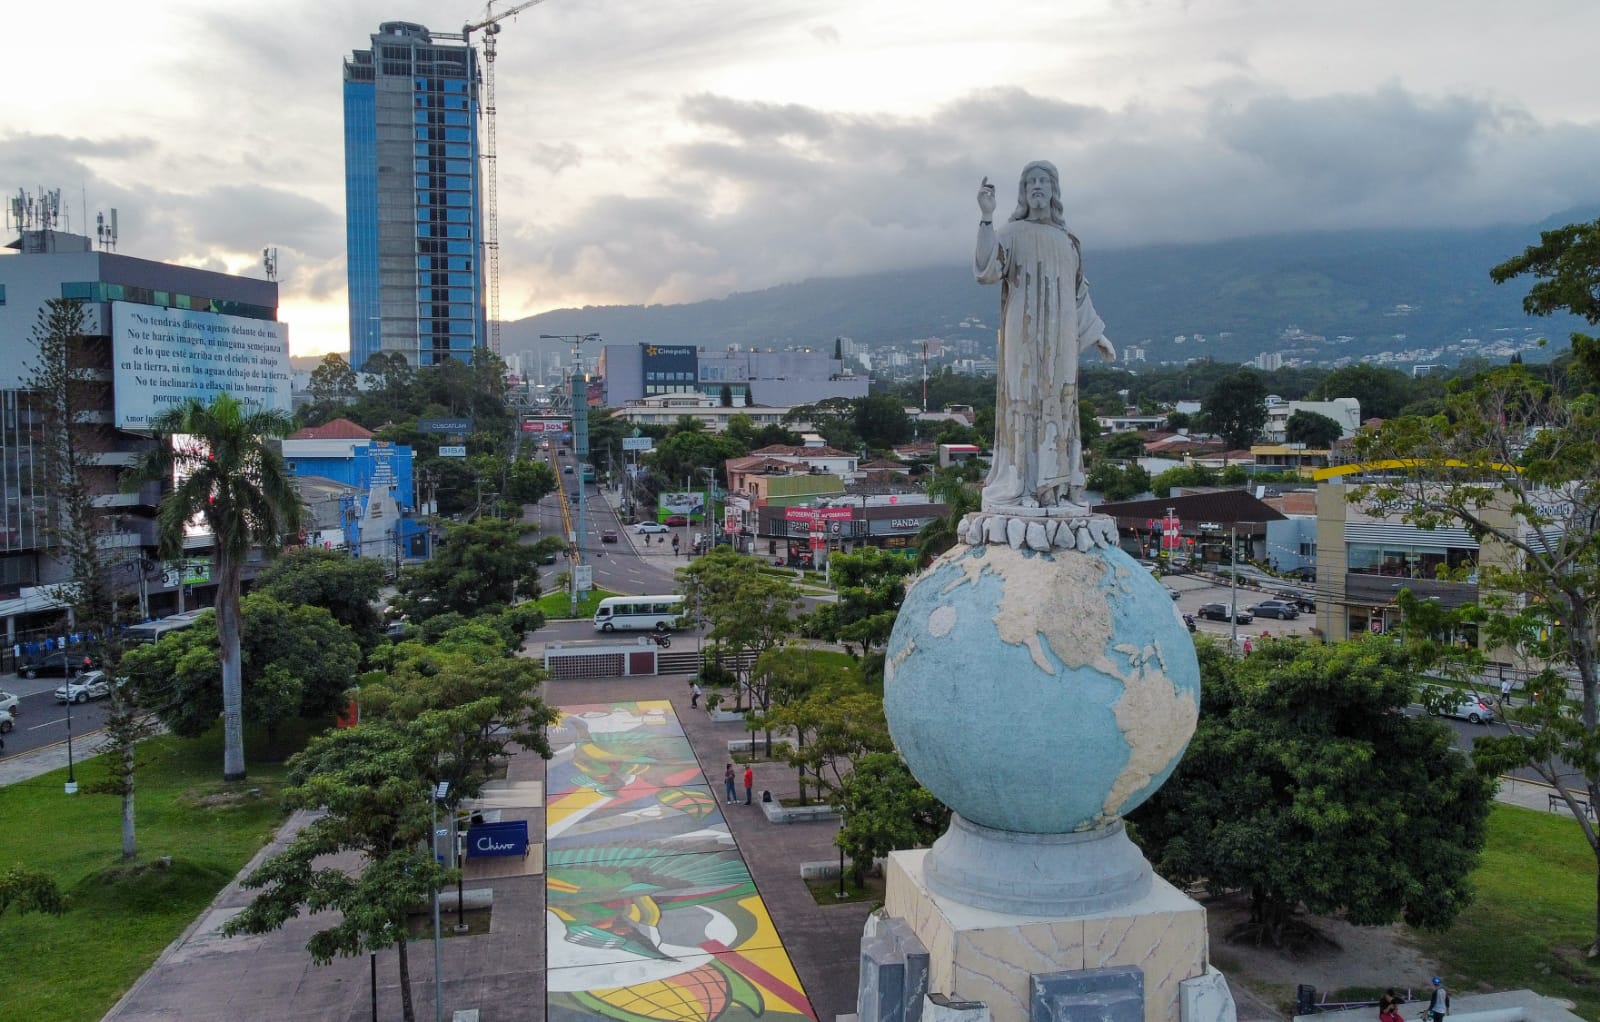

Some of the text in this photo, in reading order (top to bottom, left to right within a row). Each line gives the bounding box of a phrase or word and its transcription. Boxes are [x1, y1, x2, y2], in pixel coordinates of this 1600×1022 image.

[232, 325, 256, 337] delante
[258, 328, 266, 338] de
[127, 328, 140, 340] No
[142, 331, 150, 341] te
[217, 338, 245, 351] ninguna
[133, 345, 144, 355] de
[145, 346, 153, 356] lo
[155, 349, 171, 359] que
[189, 350, 212, 361] arriba
[214, 353, 222, 361] en
[224, 353, 231, 362] el
[121, 361, 131, 370] en
[133, 360, 142, 371] la
[172, 363, 180, 373] ni
[181, 365, 191, 373] en
[192, 364, 203, 374] las
[205, 368, 226, 377] aguas
[227, 367, 251, 380] debajo
[252, 369, 260, 378] de
[261, 369, 268, 379] la
[135, 375, 148, 386] No
[149, 378, 158, 386] te
[234, 382, 244, 391] las
[153, 394, 181, 405] porque
[891, 519, 920, 528] PANDA
[477, 837, 516, 851] Chivo
